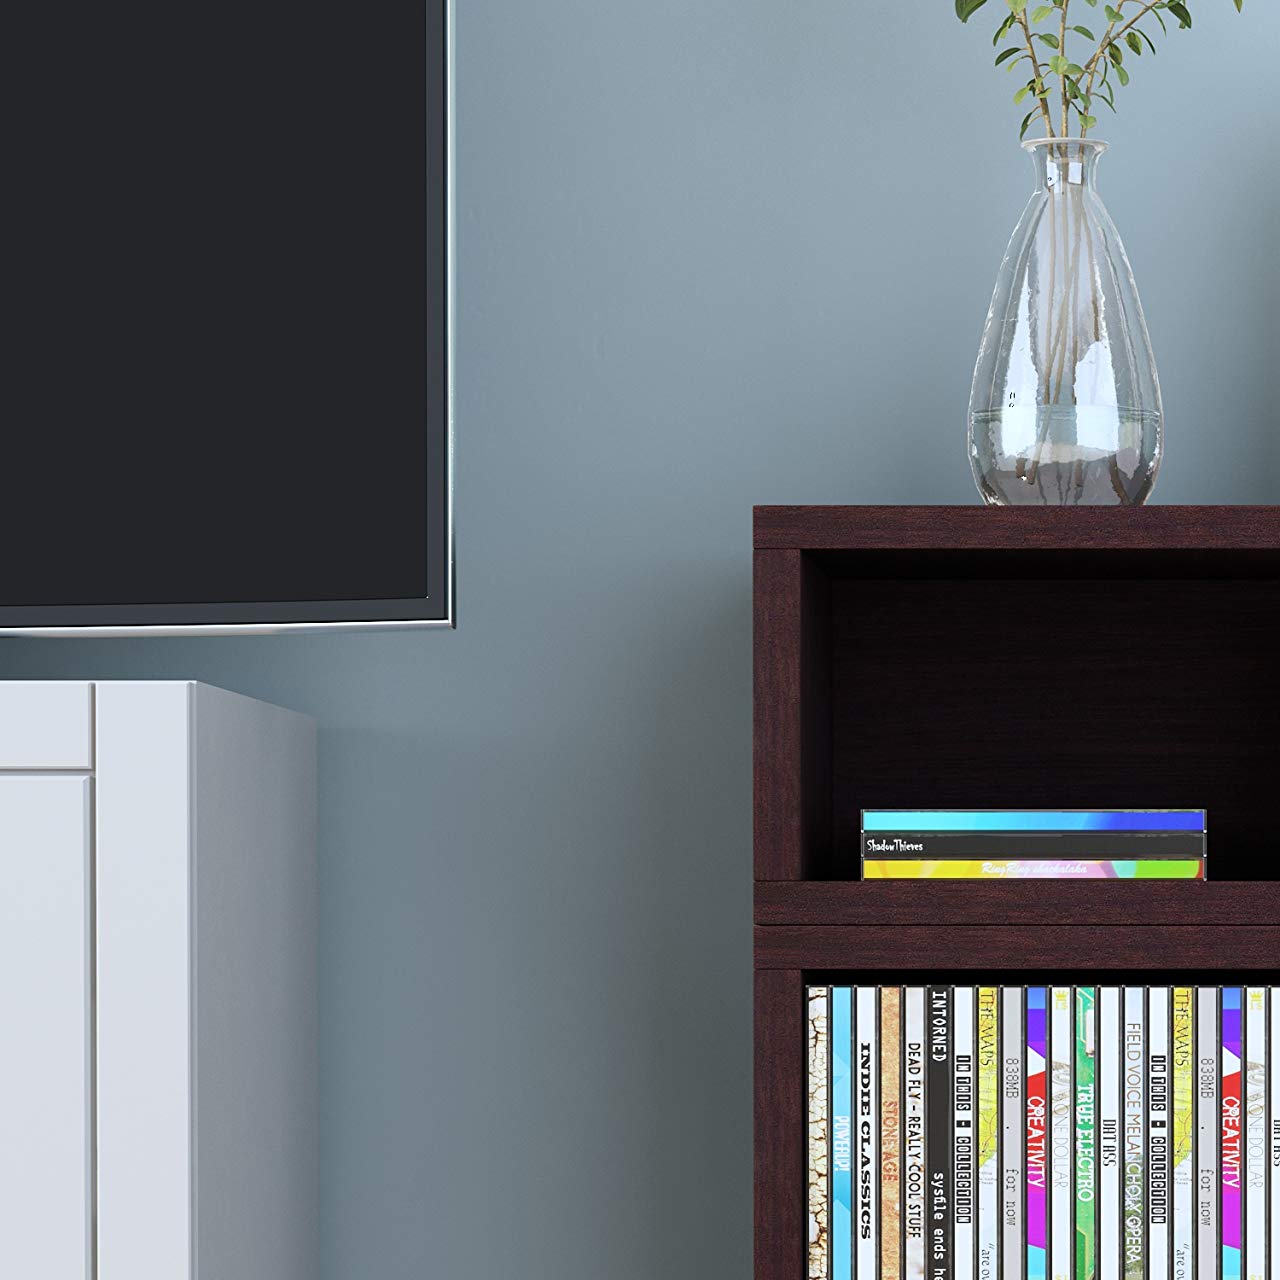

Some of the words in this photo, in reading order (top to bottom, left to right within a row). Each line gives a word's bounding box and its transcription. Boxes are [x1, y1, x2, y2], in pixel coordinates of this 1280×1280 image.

[981, 991, 994, 1020] THE
[933, 991, 947, 1061] INTORNED
[981, 1025, 994, 1065] MAPS
[1128, 1022, 1141, 1060] FIELD
[909, 1042, 921, 1074] DEAD
[956, 1055, 971, 1071] IN
[1006, 1057, 1018, 1098] 838MB
[861, 1042, 871, 1116] INDIE
[909, 1080, 921, 1099] FLY
[956, 1077, 971, 1110] THIS
[1128, 1065, 1141, 1107] VOICE
[883, 1101, 898, 1146] STONE
[1054, 1104, 1068, 1133] ONE
[1078, 1083, 1093, 1124] TRUE
[909, 1116, 921, 1158] REALLY
[1028, 1096, 1044, 1187] CREATIVITY
[1103, 1119, 1116, 1141] DAT
[883, 1151, 898, 1181] AGE
[1054, 1138, 1068, 1188] DOLLAR
[1078, 1129, 1093, 1201] ELECTRO
[1103, 1145, 1116, 1166] ASS
[1127, 1114, 1141, 1211] MELANCHOLY
[861, 1121, 871, 1239] CLASSICS
[909, 1165, 921, 1199] COOL
[932, 1173, 946, 1220] sysfile
[956, 1136, 971, 1223] COLLECTION
[1006, 1169, 1019, 1192] for
[909, 1204, 921, 1238] STUFF
[1006, 1201, 1016, 1226] now
[934, 1229, 946, 1260] ends
[1128, 1217, 1141, 1263] OPERA
